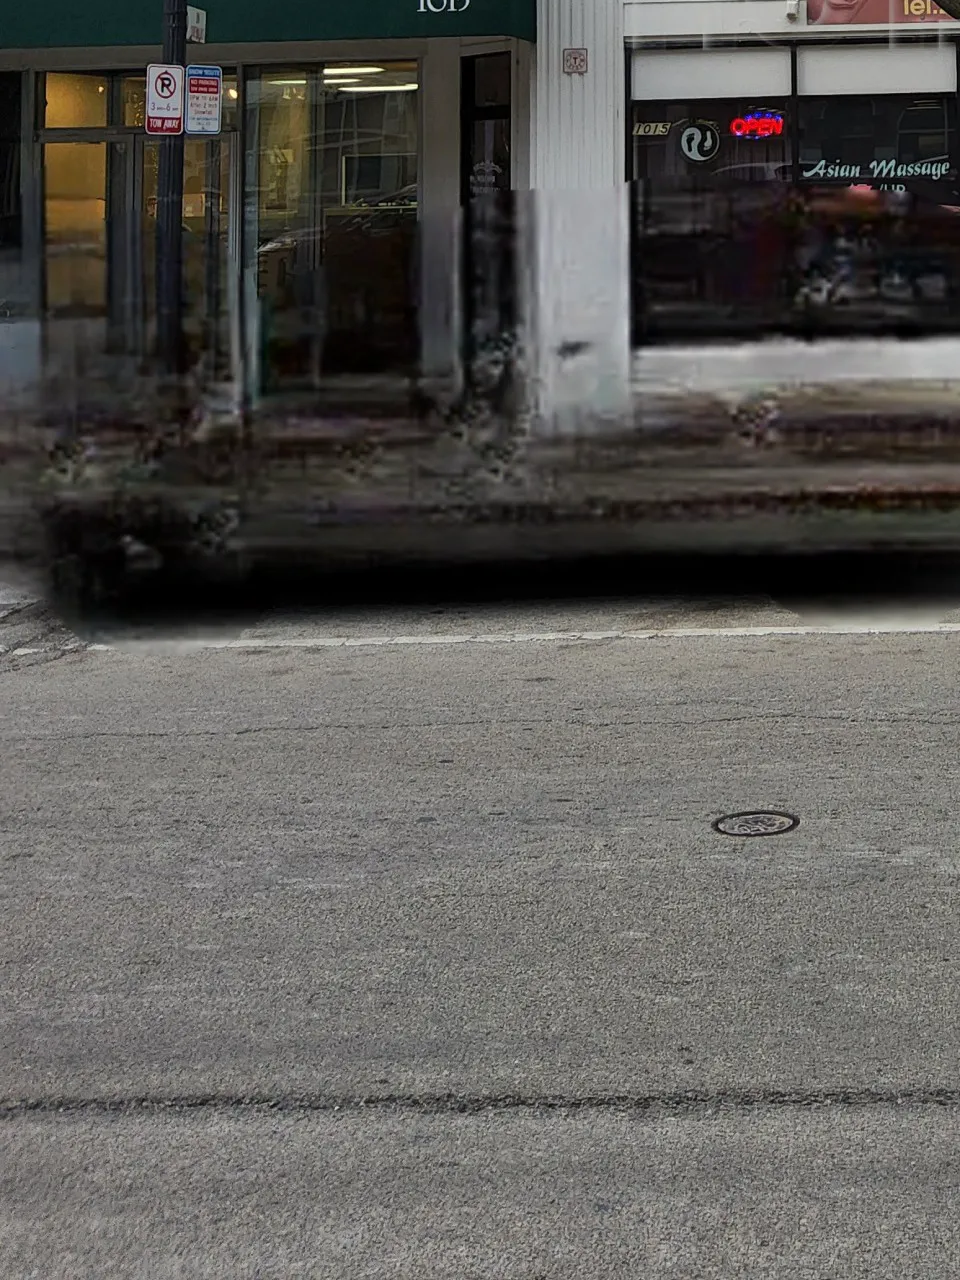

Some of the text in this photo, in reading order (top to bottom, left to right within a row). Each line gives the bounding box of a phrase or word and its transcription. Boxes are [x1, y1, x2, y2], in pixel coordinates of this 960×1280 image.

[149, 118, 163, 128] TOW
[635, 123, 669, 134] 1015
[729, 117, 784, 136] OPEN
[802, 158, 951, 181] Asian Massage
